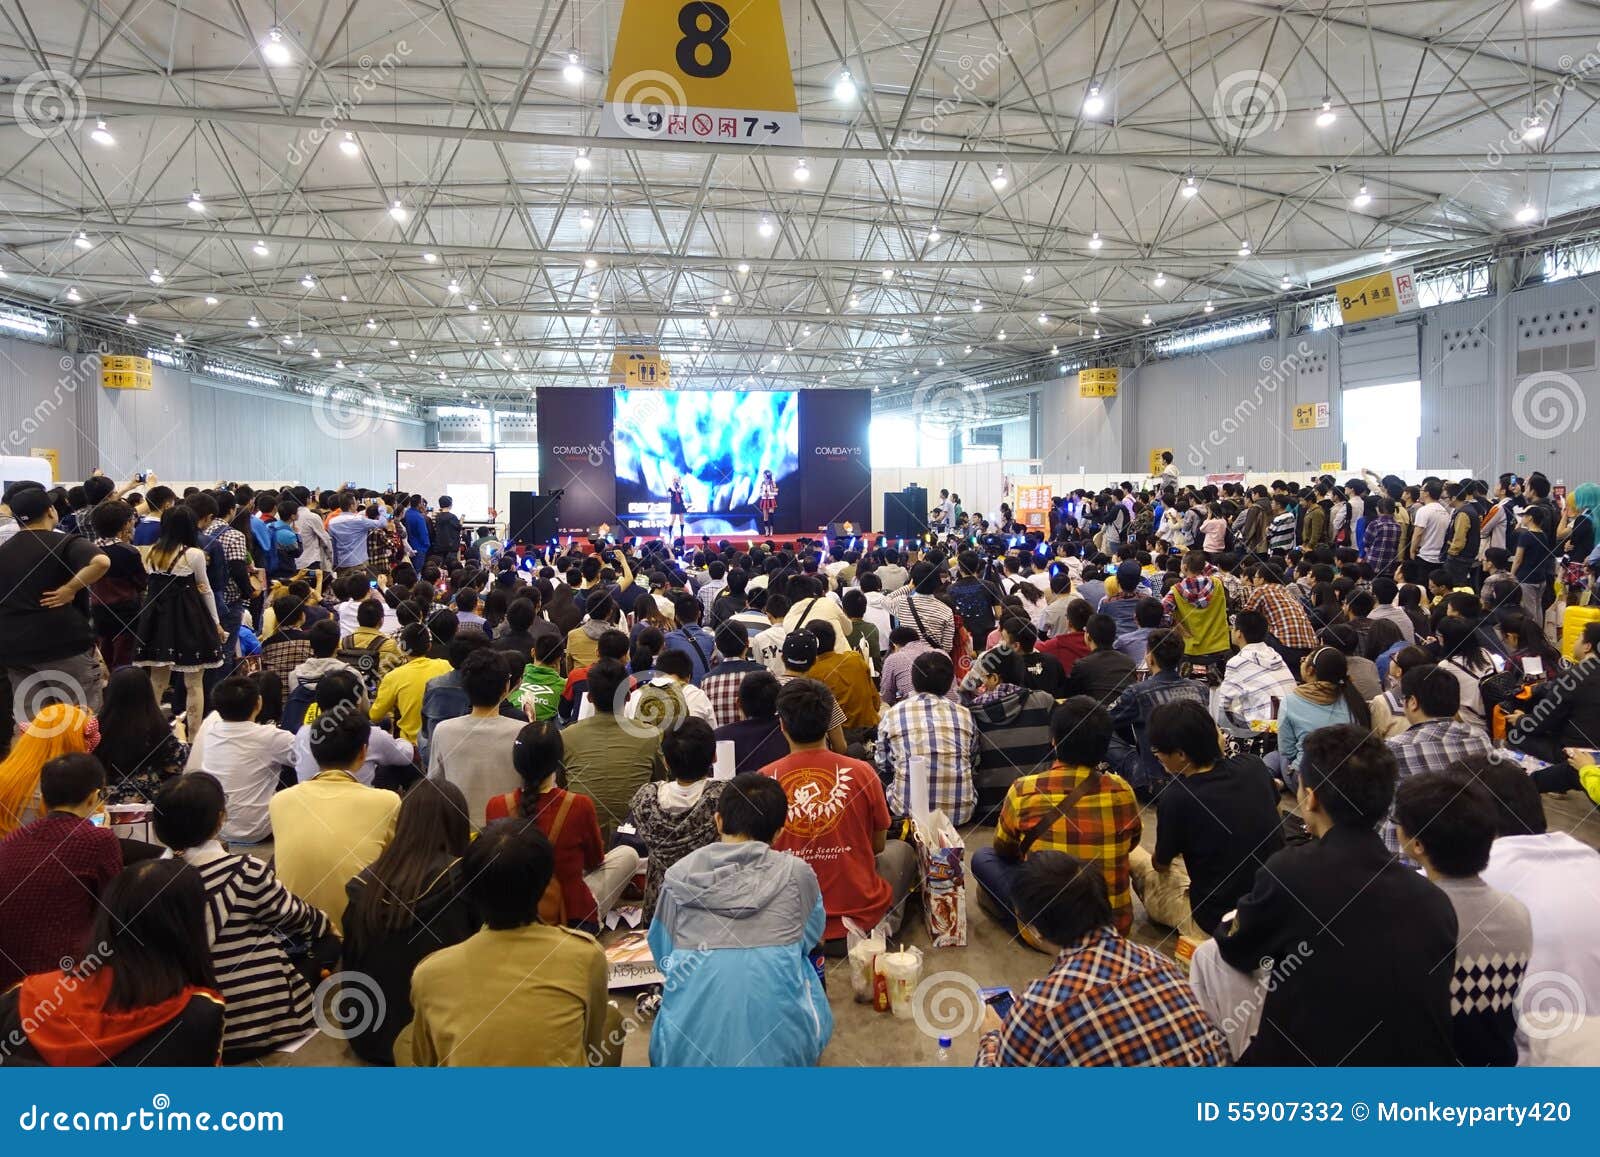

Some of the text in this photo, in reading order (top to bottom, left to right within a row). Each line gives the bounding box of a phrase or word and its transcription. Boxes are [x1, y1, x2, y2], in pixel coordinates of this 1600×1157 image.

[675, 0, 732, 79] 8
[646, 112, 760, 137] 9 7
[1342, 292, 1367, 310] 8-1
[1296, 407, 1312, 418] 8-1
